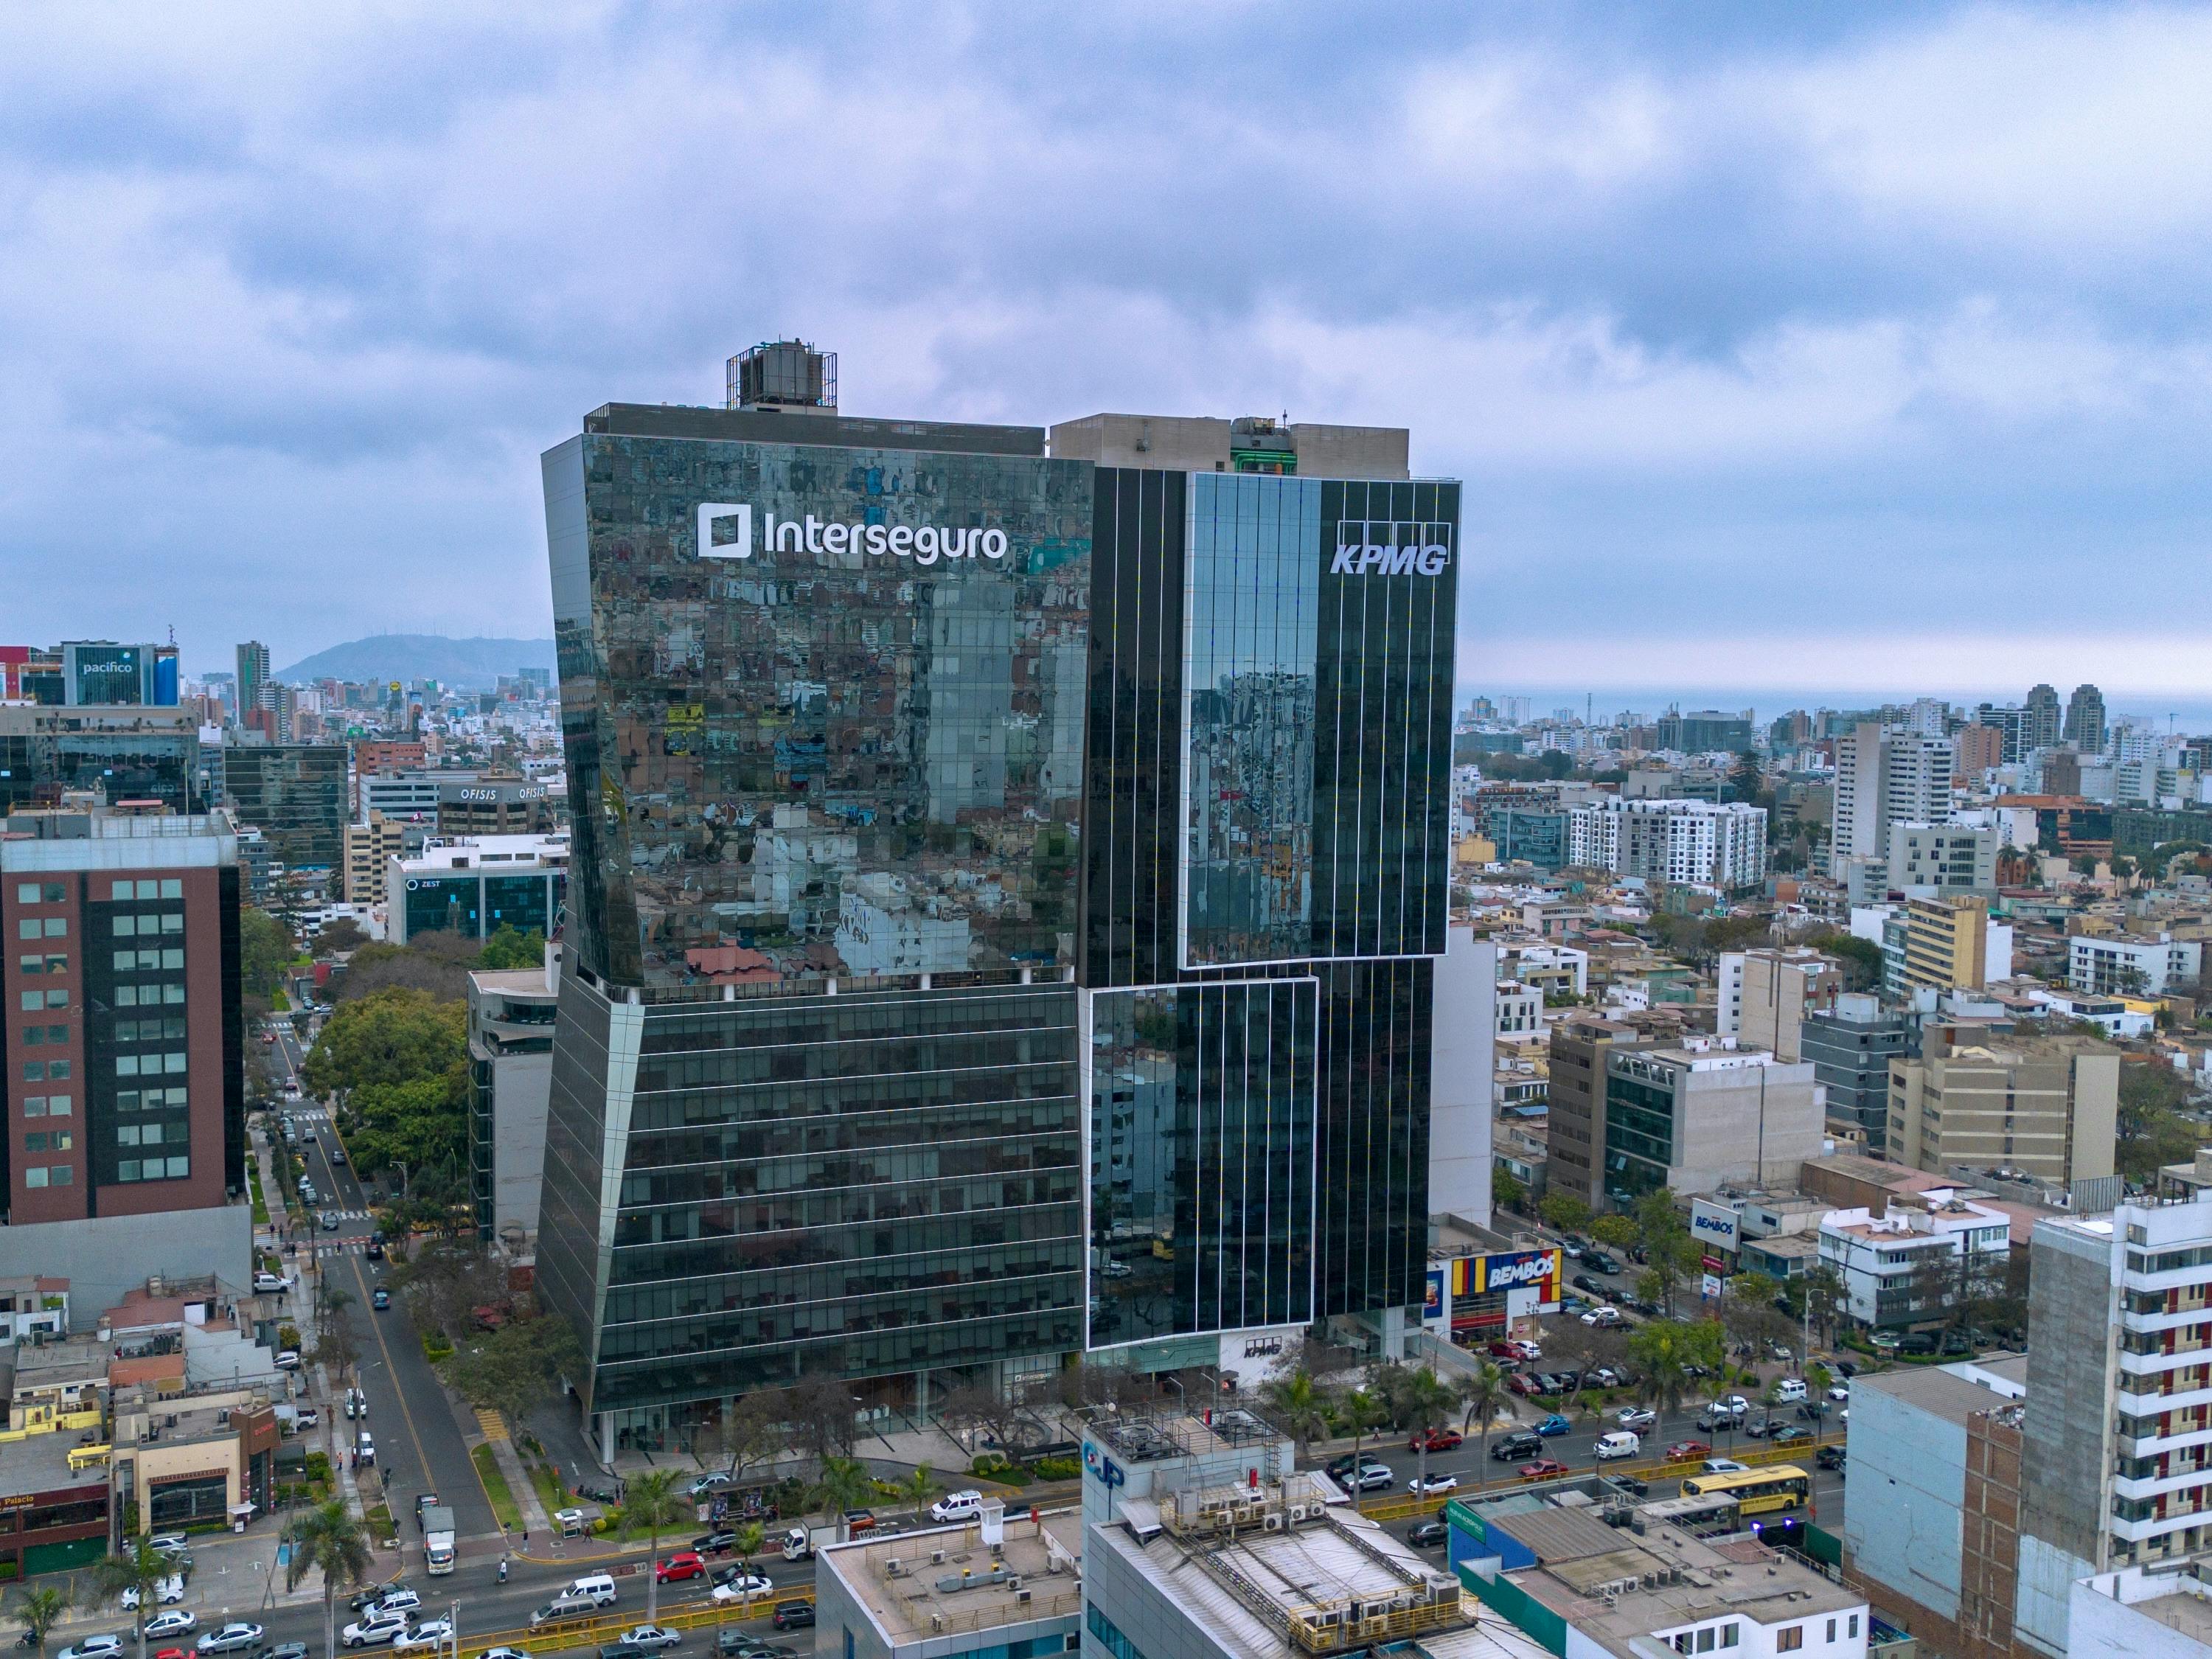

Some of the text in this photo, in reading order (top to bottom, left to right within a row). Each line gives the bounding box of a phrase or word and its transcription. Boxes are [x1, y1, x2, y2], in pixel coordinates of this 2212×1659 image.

[764, 512, 1008, 566] Interseguro
[1330, 543, 1447, 576] KPMG
[460, 789, 497, 801] OFISIS
[519, 787, 545, 799] OFISIS
[1695, 1216, 1733, 1235] BEMBOS
[1489, 1255, 1555, 1287] BEMBOS
[1082, 1441, 1124, 1489] CJP
[4, 1495, 34, 1505] Palacio
